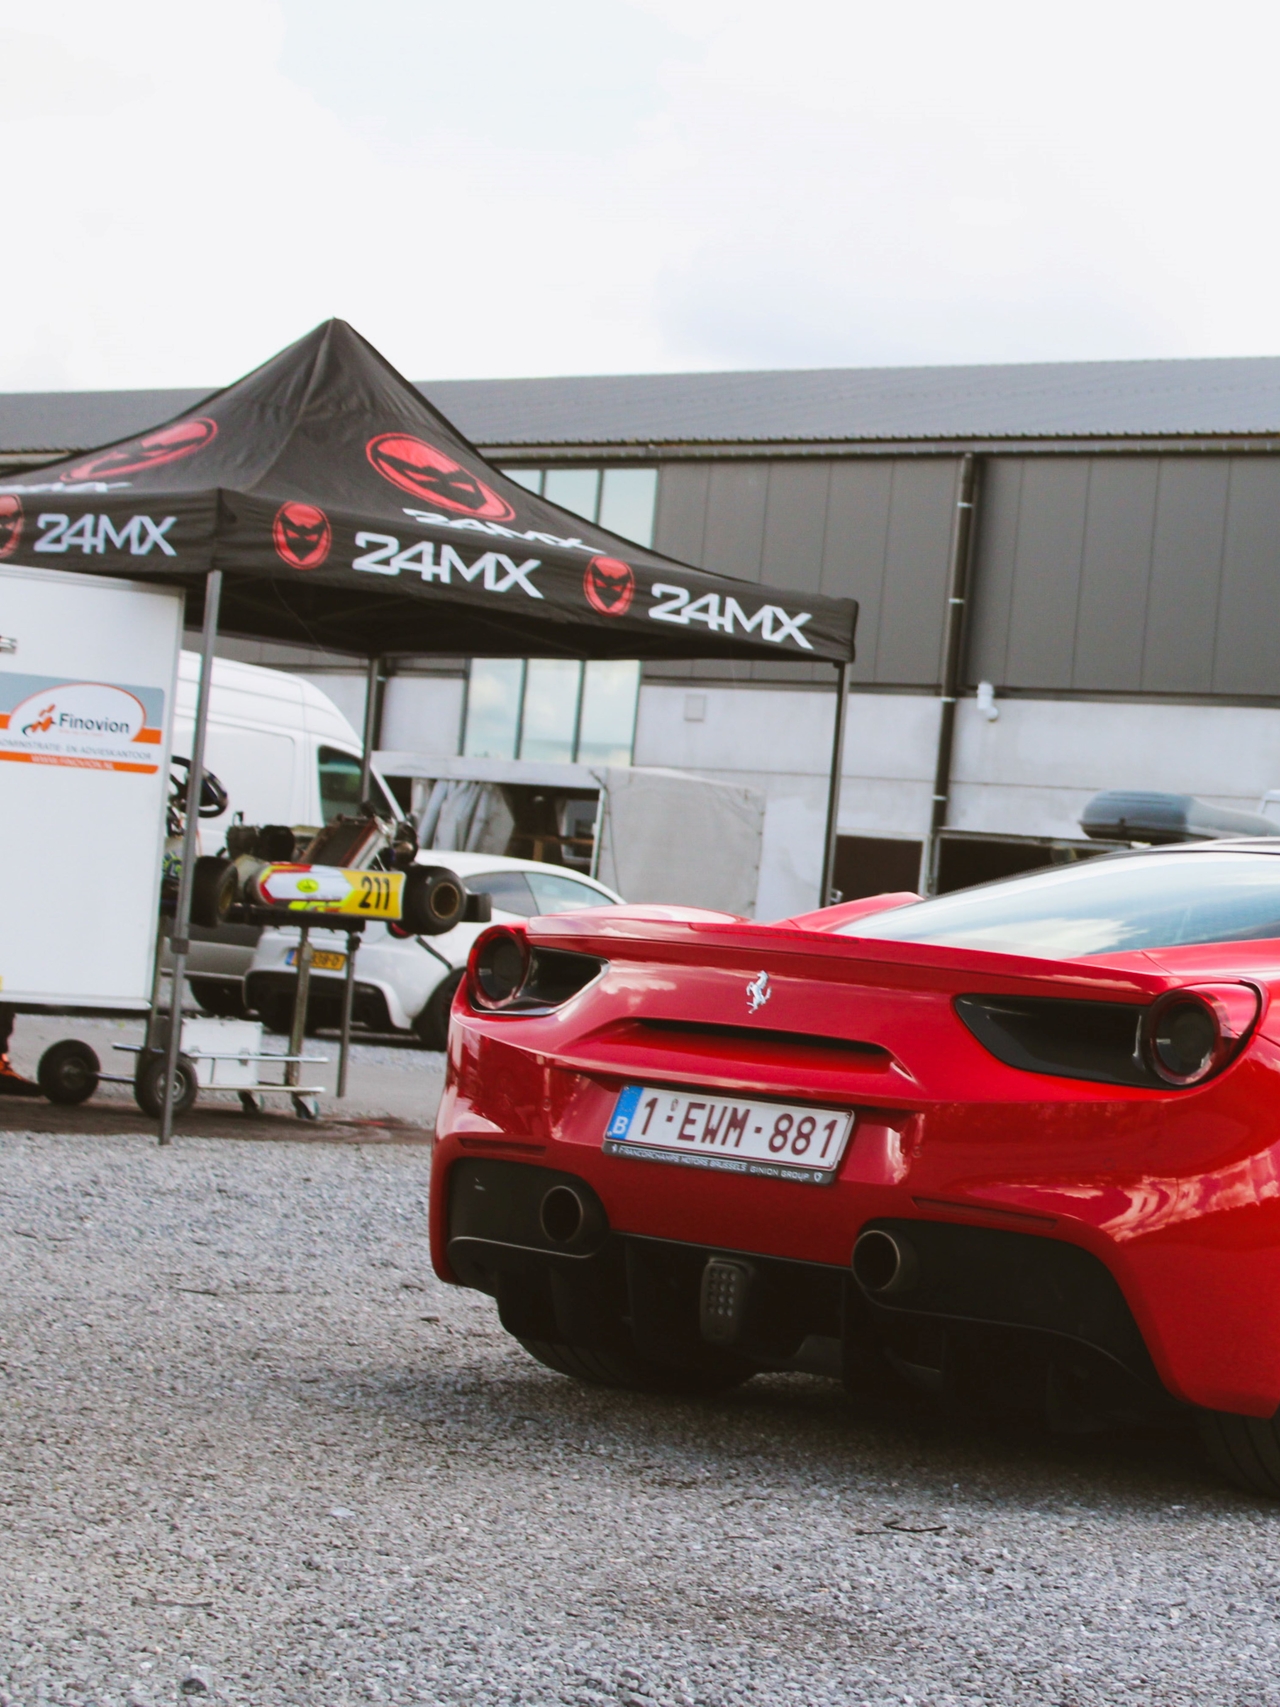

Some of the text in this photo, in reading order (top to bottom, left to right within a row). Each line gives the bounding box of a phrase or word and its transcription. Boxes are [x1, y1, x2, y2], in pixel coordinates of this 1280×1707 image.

[33, 513, 178, 556] 24MX
[352, 531, 545, 600] 24MX
[648, 582, 814, 650] 24MX
[59, 712, 130, 734] Finovion
[359, 875, 390, 910] 211
[612, 1115, 629, 1135] B
[680, 1155, 708, 1167] MOTORS
[709, 1158, 747, 1173] BRUSSELS
[750, 1165, 779, 1177] GINION
[781, 1169, 810, 1181] GROUP
